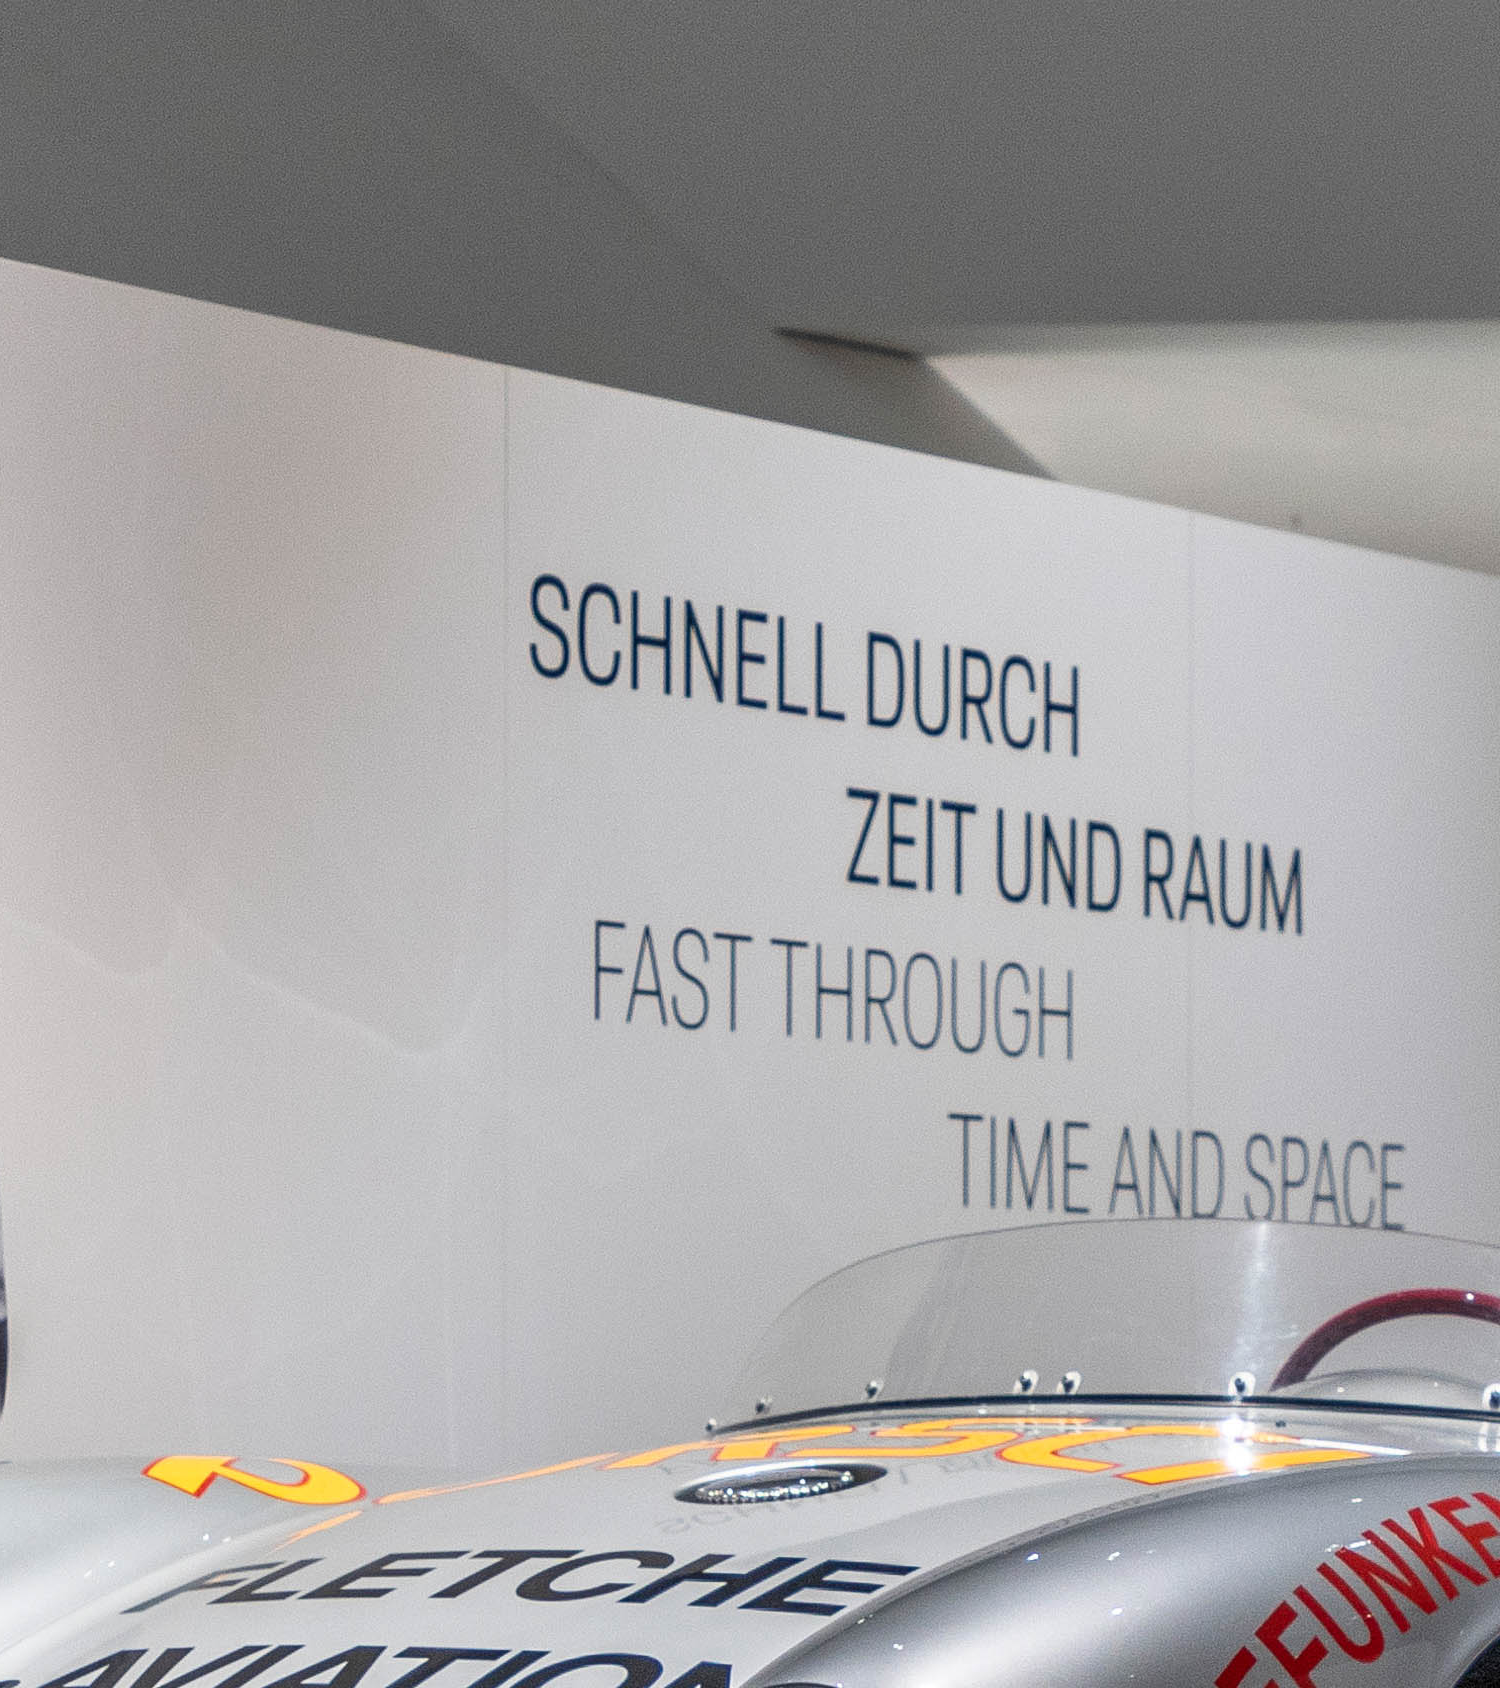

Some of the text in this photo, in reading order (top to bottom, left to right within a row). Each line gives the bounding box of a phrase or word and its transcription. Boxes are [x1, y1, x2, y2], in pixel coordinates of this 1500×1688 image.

[529, 574, 1079, 757] SCHNELL DURCH
[846, 787, 1303, 936] ZEIT UND RAUM
[594, 919, 1074, 1061] FAST THROUGH
[947, 1112, 1407, 1232] TIME AND SPACE
